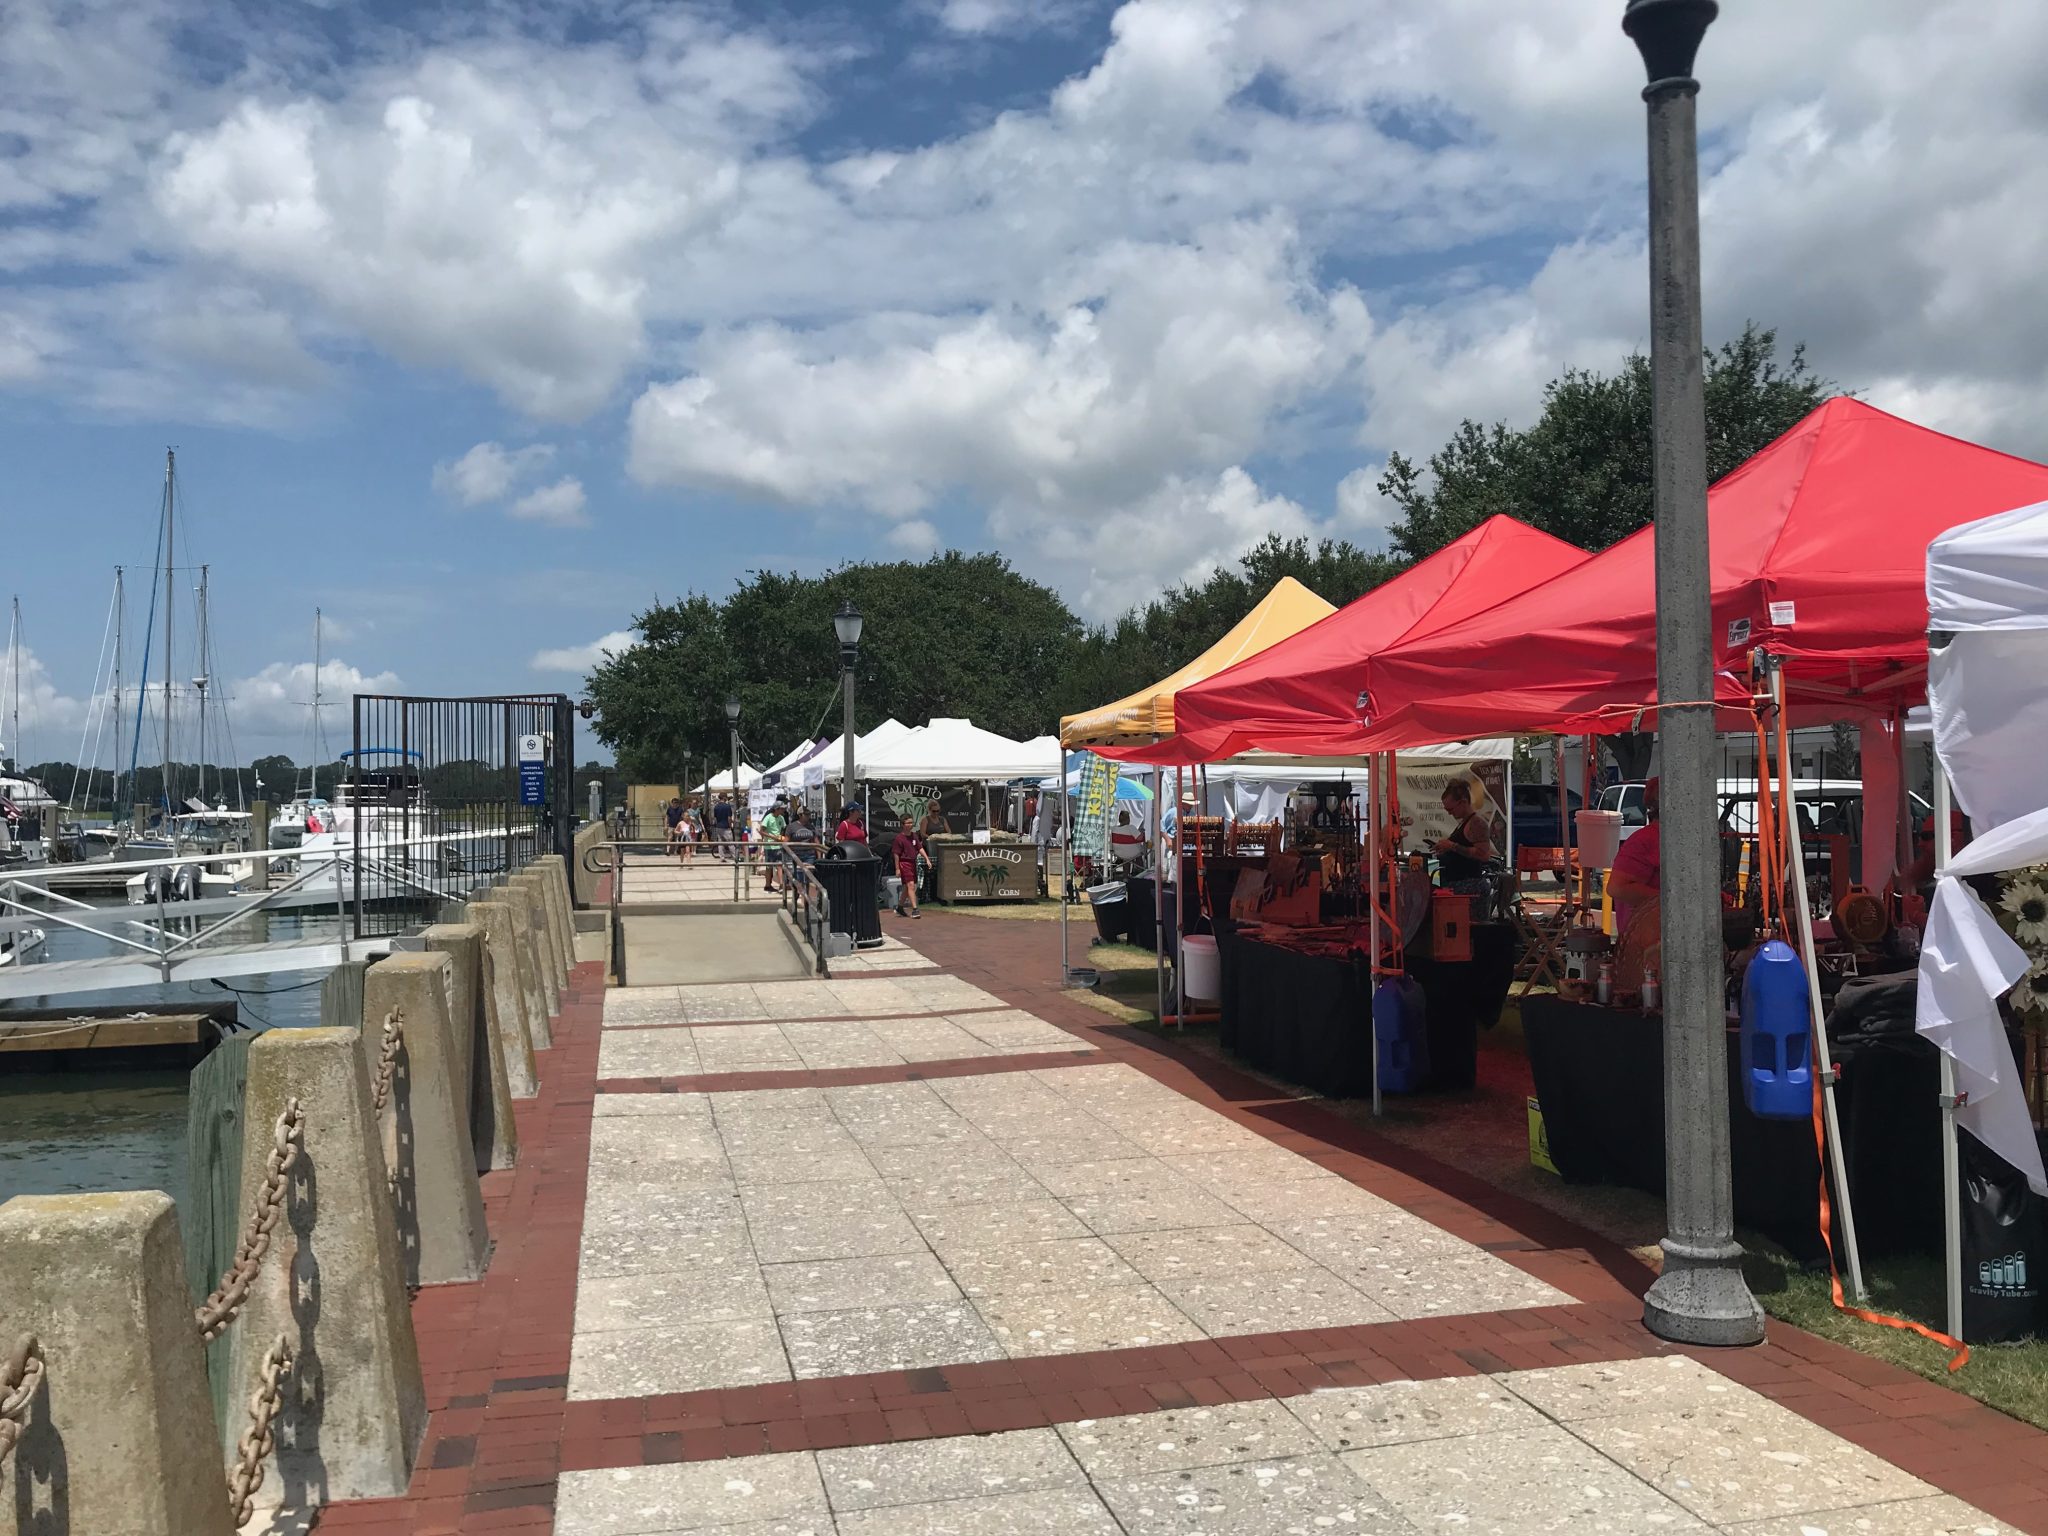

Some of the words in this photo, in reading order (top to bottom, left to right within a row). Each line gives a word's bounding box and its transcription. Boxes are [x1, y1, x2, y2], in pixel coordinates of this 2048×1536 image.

[881, 784, 942, 800] PALMETTO
[959, 848, 1022, 864] PALMETTO
[955, 889, 982, 897] KETTLE
[998, 888, 1020, 896] CORN
